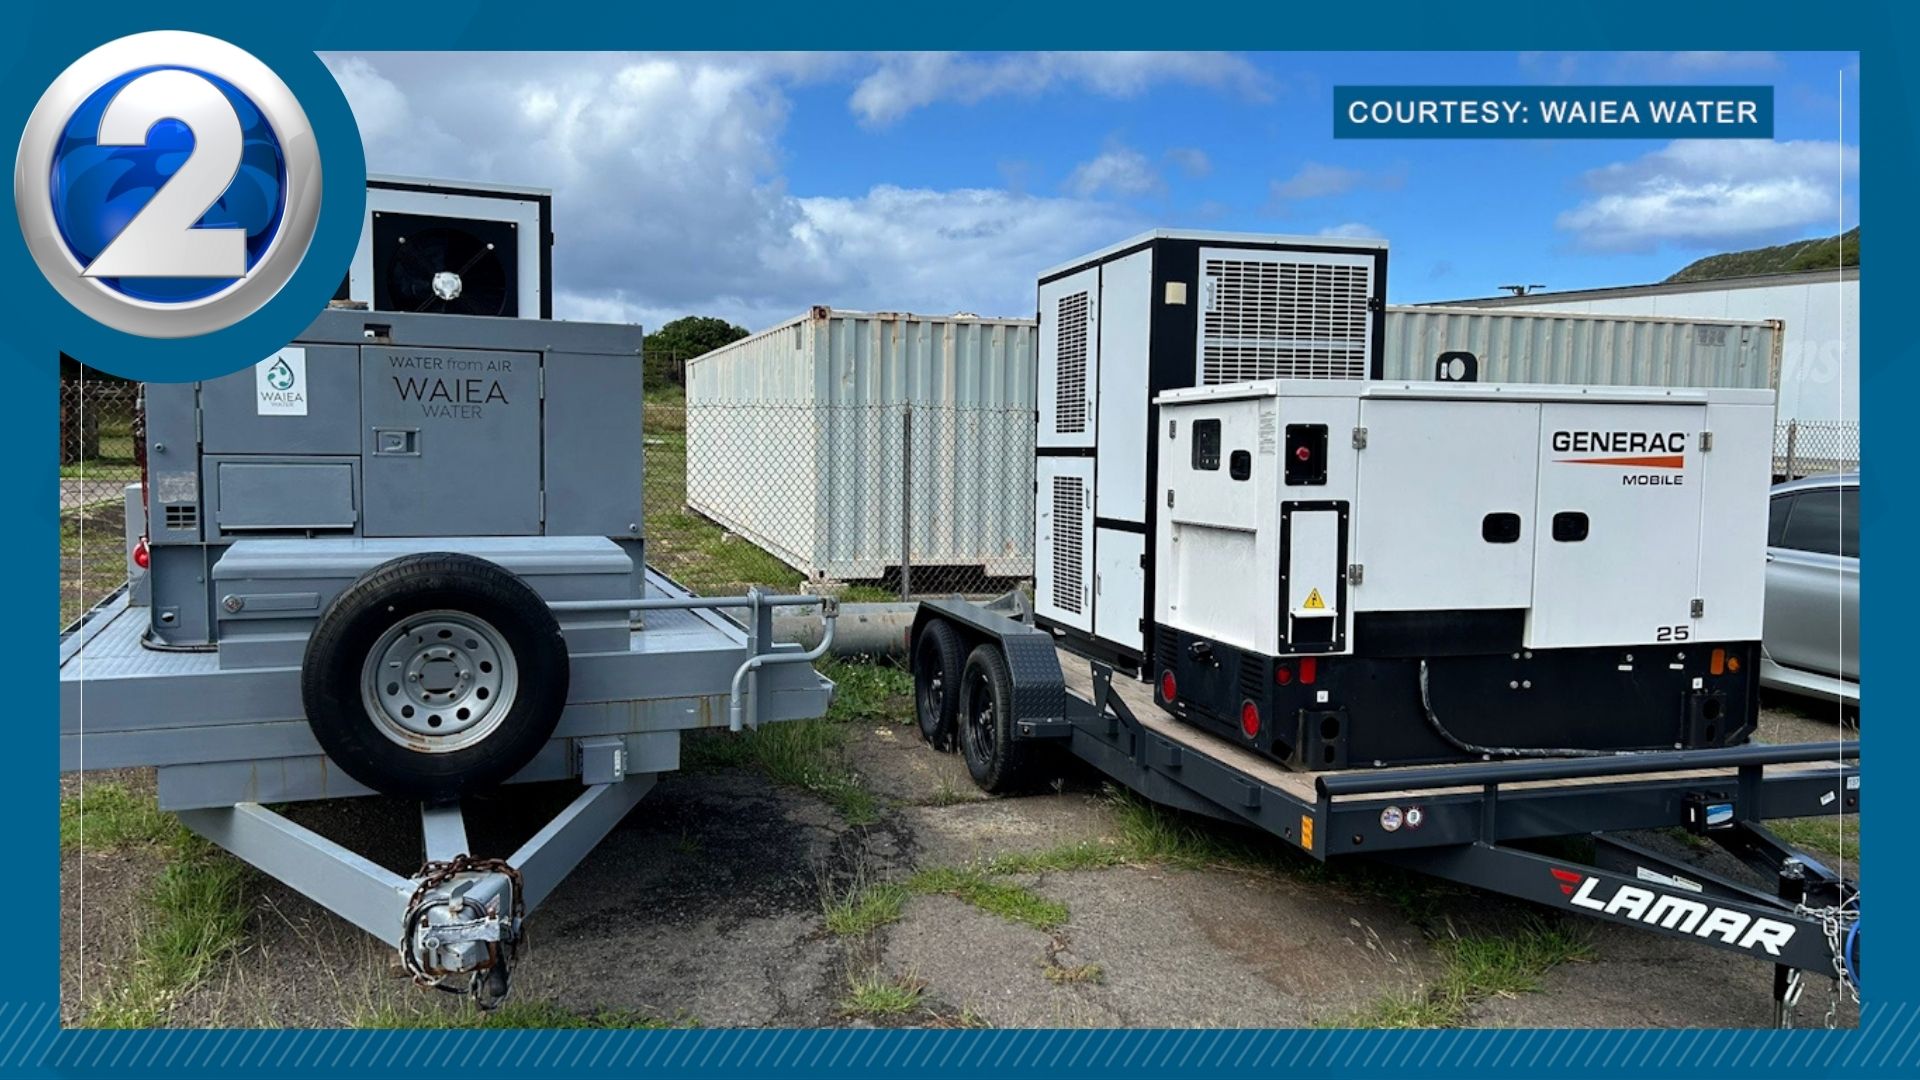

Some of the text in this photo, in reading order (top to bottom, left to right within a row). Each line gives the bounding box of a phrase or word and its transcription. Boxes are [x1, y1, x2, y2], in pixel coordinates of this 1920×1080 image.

[389, 356, 512, 372] WATER from AIR
[260, 392, 304, 402] WAIEA
[393, 376, 509, 404] WAIEA
[422, 405, 482, 419] WATER
[1552, 431, 1685, 453] GENERAC
[1622, 475, 1684, 486] MOBILE
[1657, 626, 1689, 642] 25
[1570, 876, 1796, 956] LAMAR
